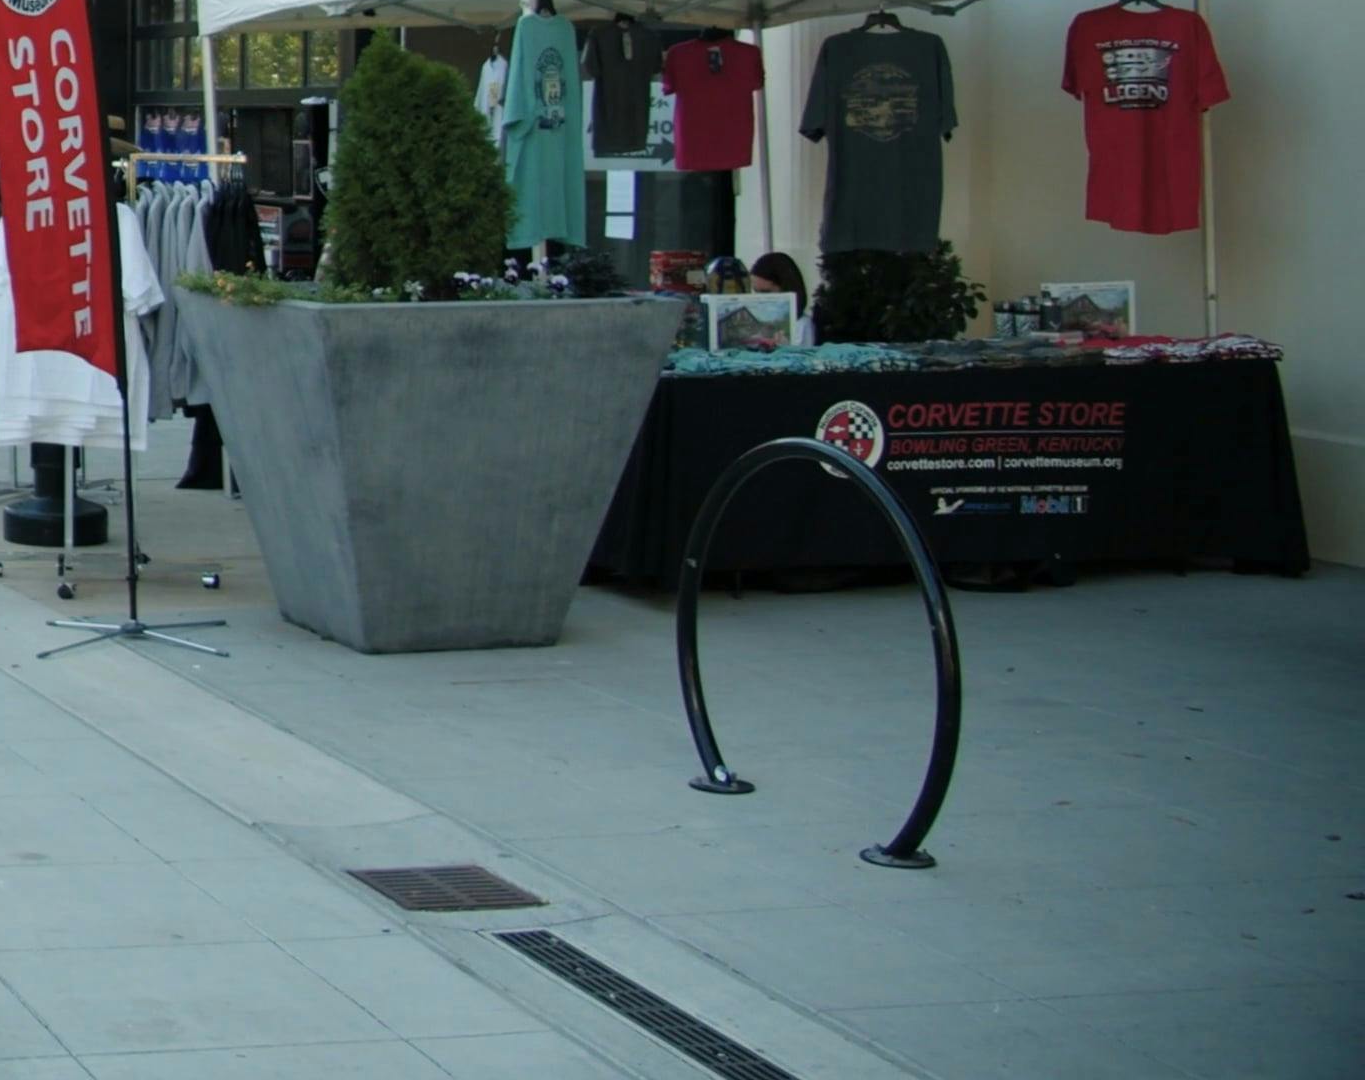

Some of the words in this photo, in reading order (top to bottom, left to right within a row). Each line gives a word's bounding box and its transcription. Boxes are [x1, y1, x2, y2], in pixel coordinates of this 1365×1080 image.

[1103, 83, 1169, 103] LEGEND
[7, 34, 55, 233] STORE
[49, 27, 94, 339] CORVETTE
[888, 402, 1031, 428] CORVETTE
[1036, 401, 1126, 426] STORE
[891, 438, 967, 455] BOWLING
[971, 436, 1033, 454] GREEN,
[1036, 435, 1125, 452] KENTUCKY
[887, 458, 995, 471] corvettestore.com
[1003, 456, 1123, 470] corvettemuseum.org
[1020, 495, 1069, 514] Mobil
